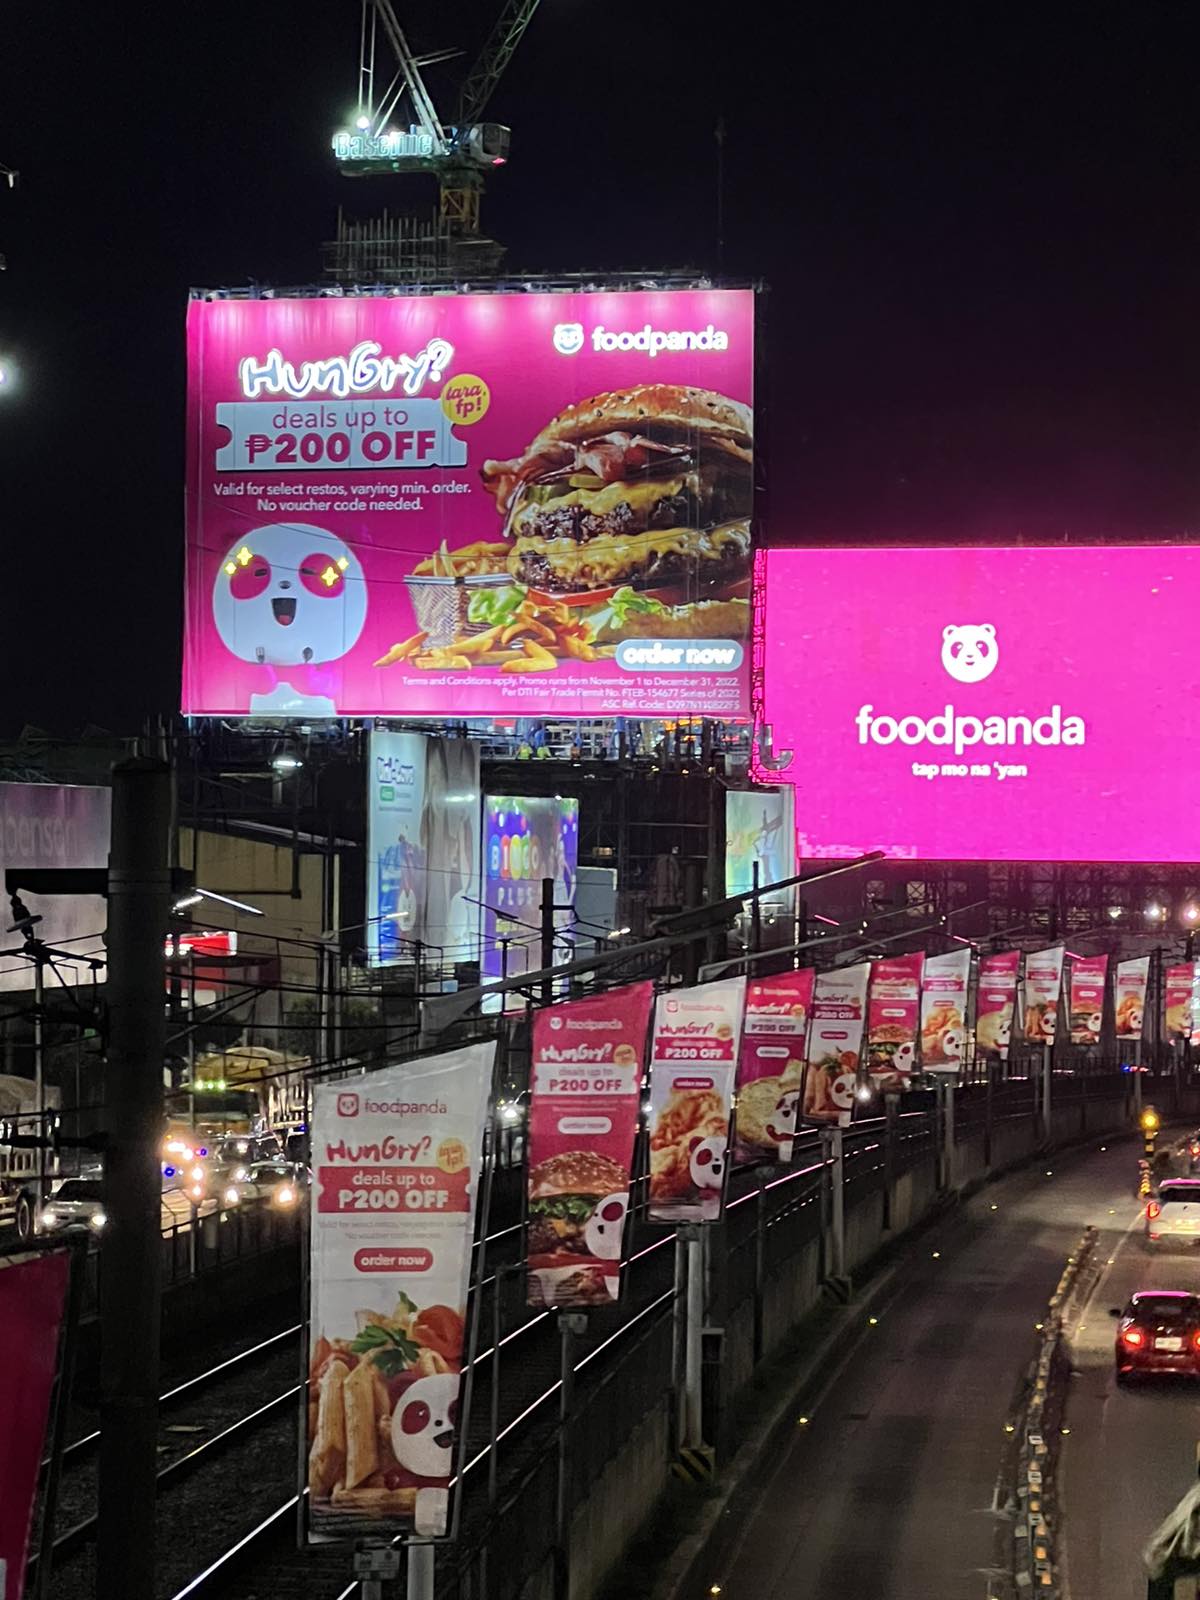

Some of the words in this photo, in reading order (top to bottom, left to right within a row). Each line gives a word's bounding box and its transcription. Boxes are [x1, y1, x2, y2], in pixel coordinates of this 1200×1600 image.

[592, 324, 728, 357] foodpanda
[456, 396, 481, 418] fp!
[272, 405, 337, 429] deals
[345, 411, 376, 433] up
[383, 407, 408, 425] to
[361, 430, 436, 462] OFF
[213, 482, 244, 496] Valid
[246, 481, 265, 496] for
[266, 482, 304, 495] select
[306, 483, 348, 496] restos,
[350, 482, 398, 498] varying
[401, 481, 430, 494] min.
[431, 479, 472, 494] order.
[256, 498, 277, 511] No
[279, 498, 331, 511] voucher
[333, 498, 367, 511] code
[369, 497, 424, 510] needed.
[623, 643, 684, 664] order
[685, 648, 736, 664] now
[429, 676, 446, 685] and
[447, 676, 492, 686] Conditions
[519, 676, 548, 686] Promo
[589, 677, 635, 686] November
[643, 677, 653, 686] to
[653, 677, 699, 687] December
[855, 704, 1086, 755] foodpanda
[912, 762, 939, 780] tap
[941, 765, 968, 777] mo
[970, 765, 991, 777] na
[699, 1048, 724, 1058] OFF
[593, 1079, 622, 1092] OFF
[364, 1098, 447, 1117] foodpanda
[352, 1171, 392, 1186] deals
[396, 1173, 416, 1189] up
[420, 1172, 435, 1185] to
[405, 1190, 448, 1208] OFF
[361, 1255, 395, 1266] order
[398, 1257, 426, 1266] now
